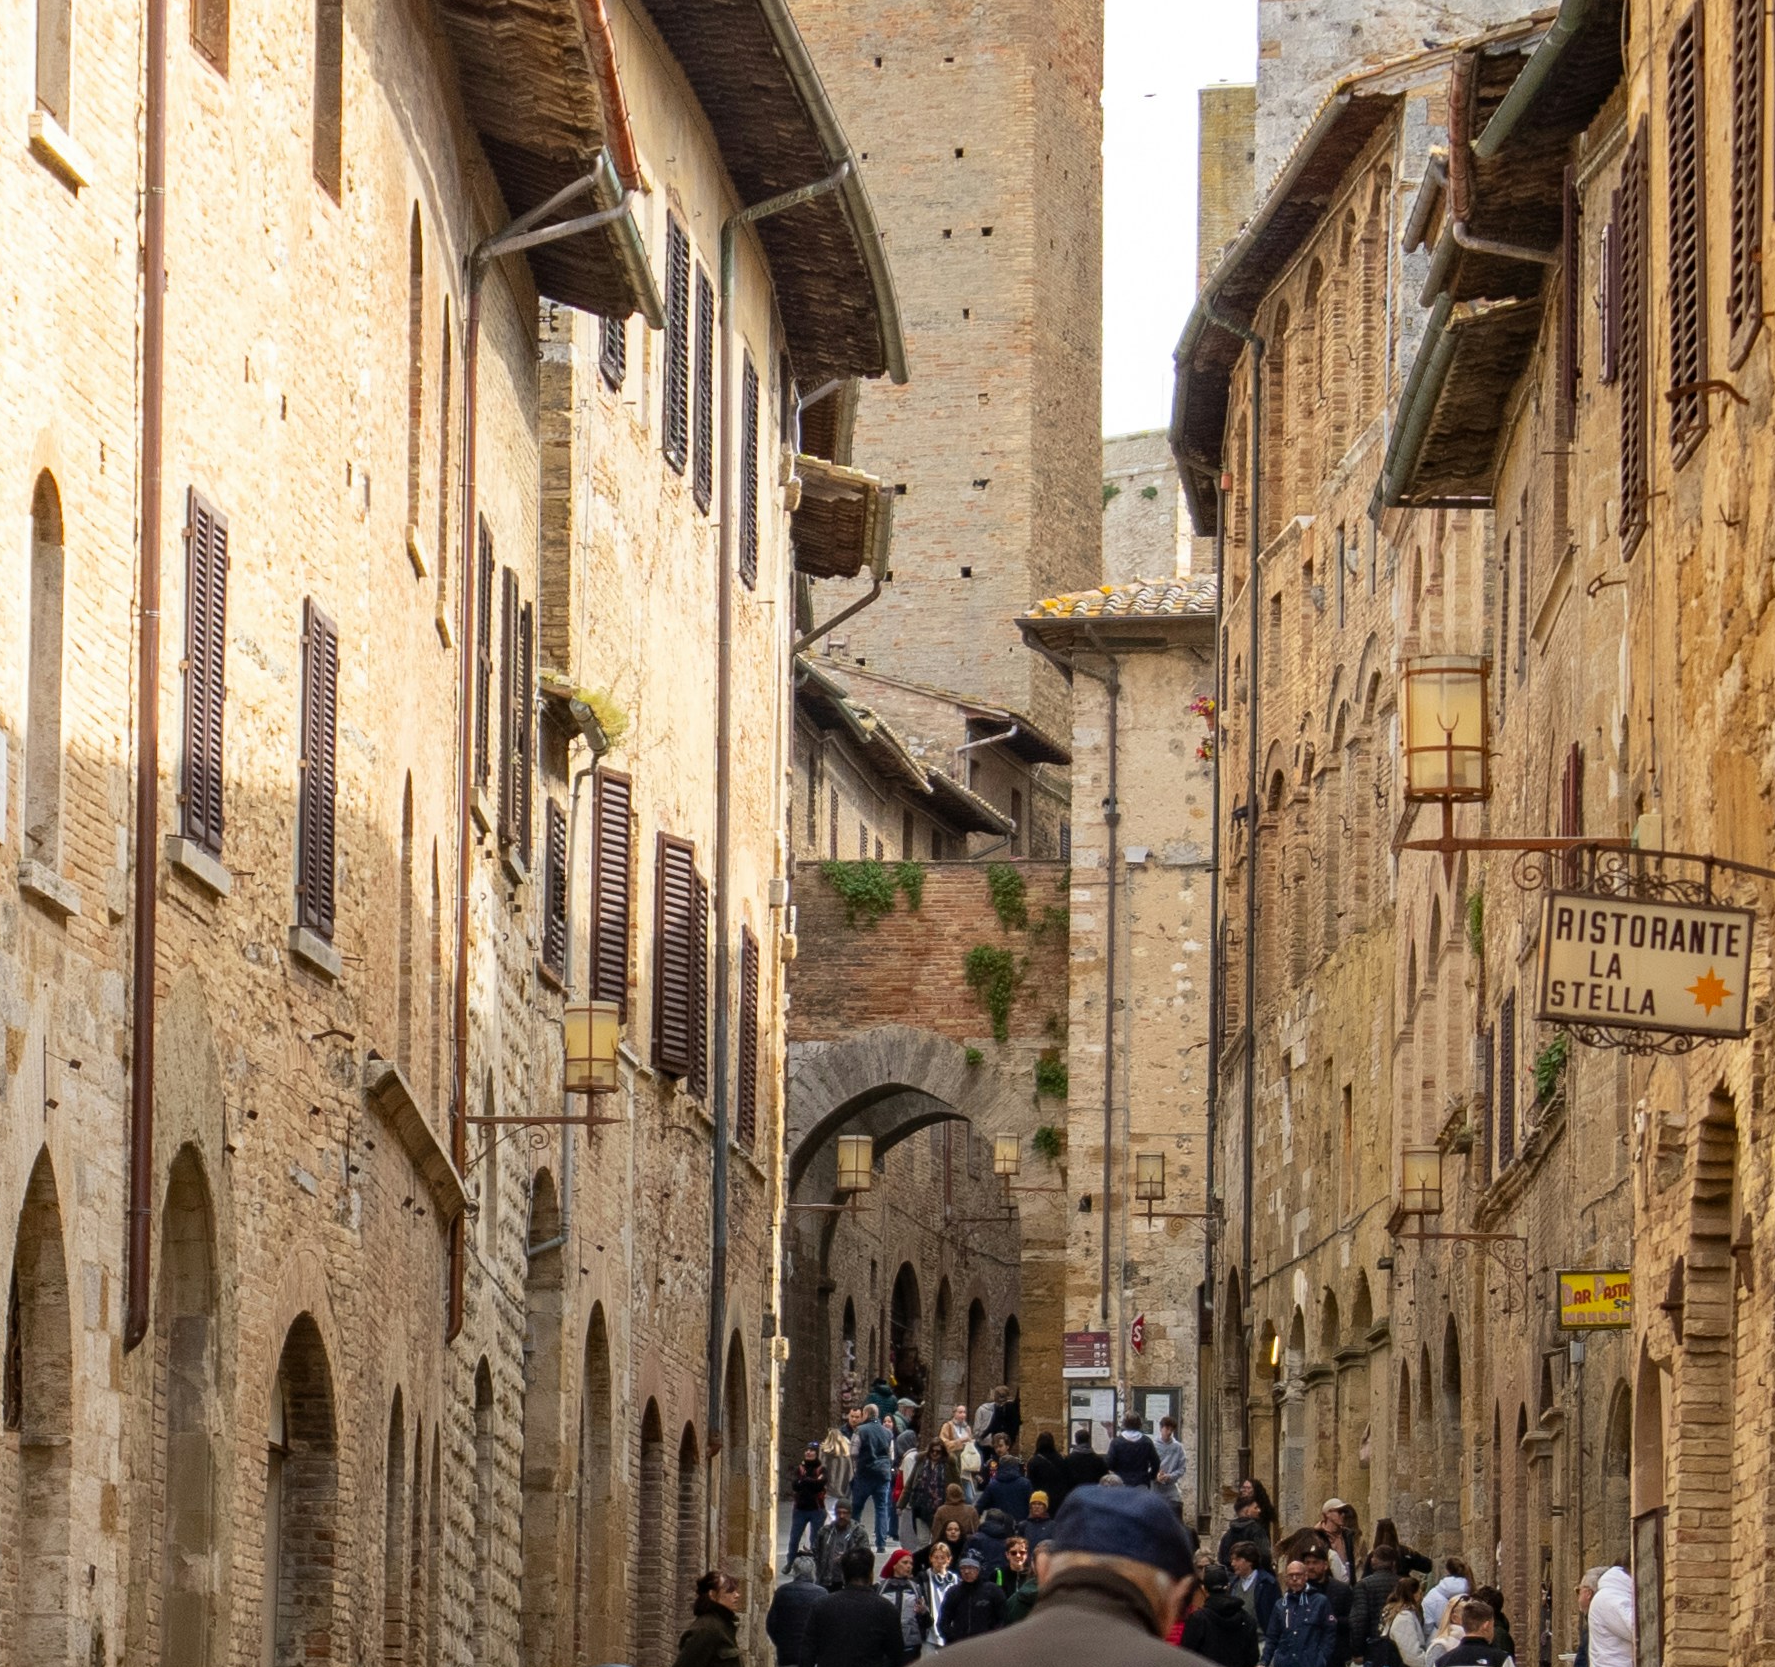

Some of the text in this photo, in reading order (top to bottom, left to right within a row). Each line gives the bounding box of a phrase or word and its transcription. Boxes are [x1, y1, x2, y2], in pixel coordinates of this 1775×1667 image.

[1556, 907, 1741, 957] RISTORANTE
[1589, 950, 1622, 980] LA
[1550, 980, 1656, 1016] STELLA
